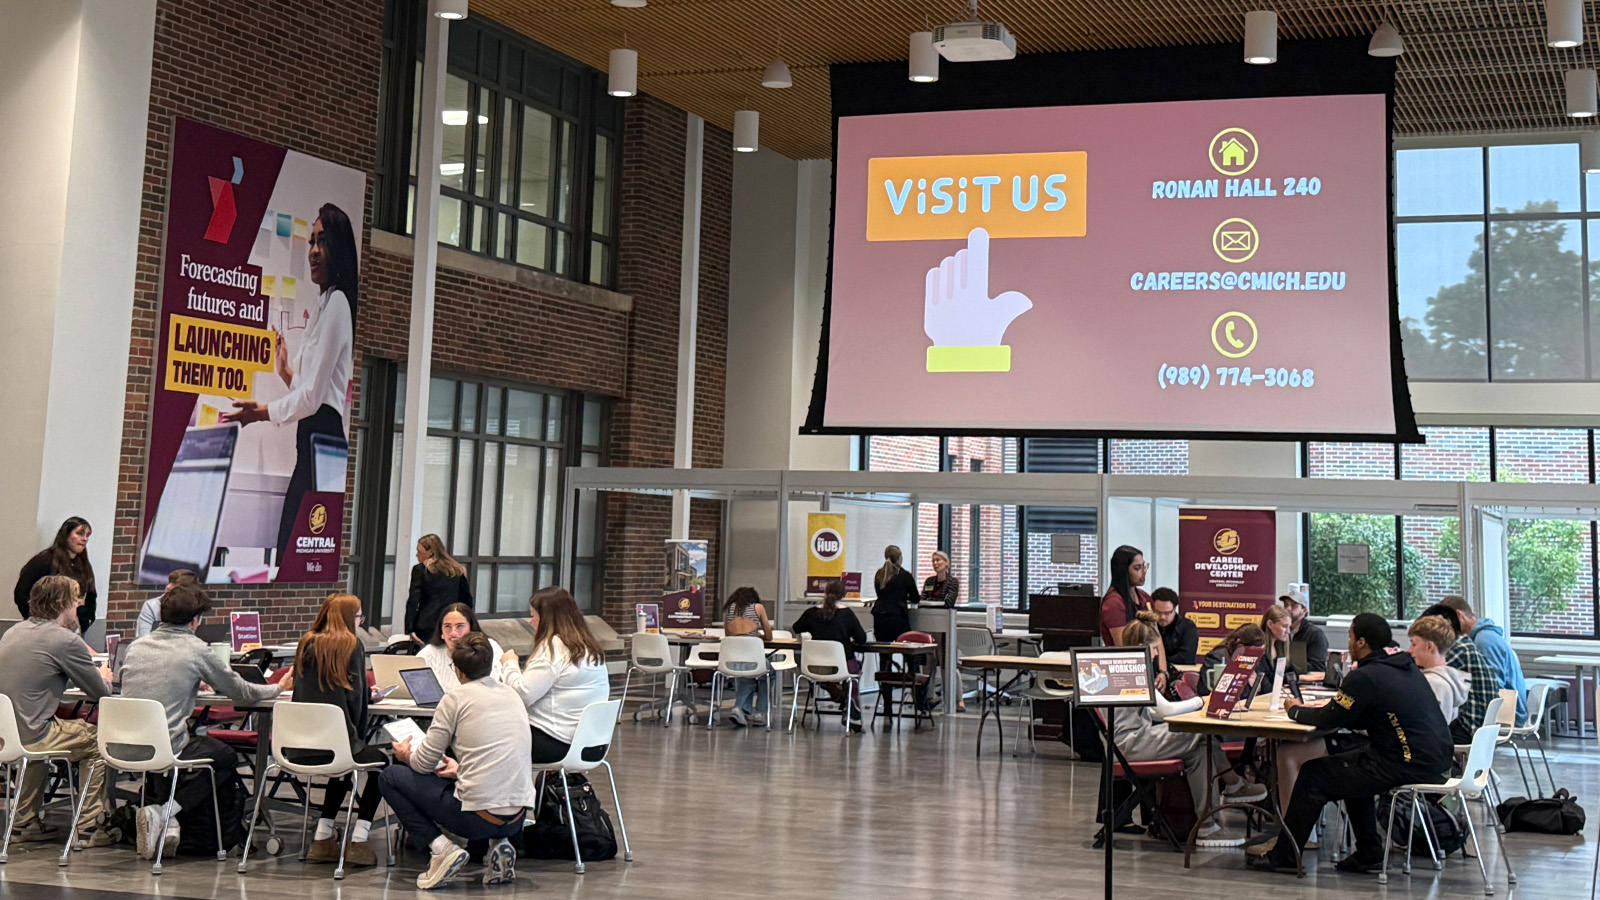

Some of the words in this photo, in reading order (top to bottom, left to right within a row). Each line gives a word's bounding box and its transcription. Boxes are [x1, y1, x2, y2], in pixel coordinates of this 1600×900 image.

[1012, 174, 1067, 212] US
[1152, 179, 1218, 199] RONAN
[1225, 178, 1277, 197] HALL
[1283, 177, 1321, 196] 240
[180, 253, 258, 297] Forecasting
[1130, 271, 1346, 291] CAREERS@CMICH.EDU
[187, 286, 236, 318] futures
[239, 299, 264, 322] and
[174, 322, 271, 365] LAUNCHING
[173, 360, 214, 388] THEM
[217, 366, 248, 392] TOO.
[1158, 363, 1210, 390] (989)
[1216, 366, 1315, 388] 774-3068
[296, 536, 336, 548] CENTRAL
[817, 540, 838, 552] HUB
[1194, 563, 1259, 571] DEVELOPMENT
[1198, 600, 1212, 608] YOUR
[1212, 601, 1246, 609] DESTINATION
[1108, 663, 1147, 673] WORKSHOP
